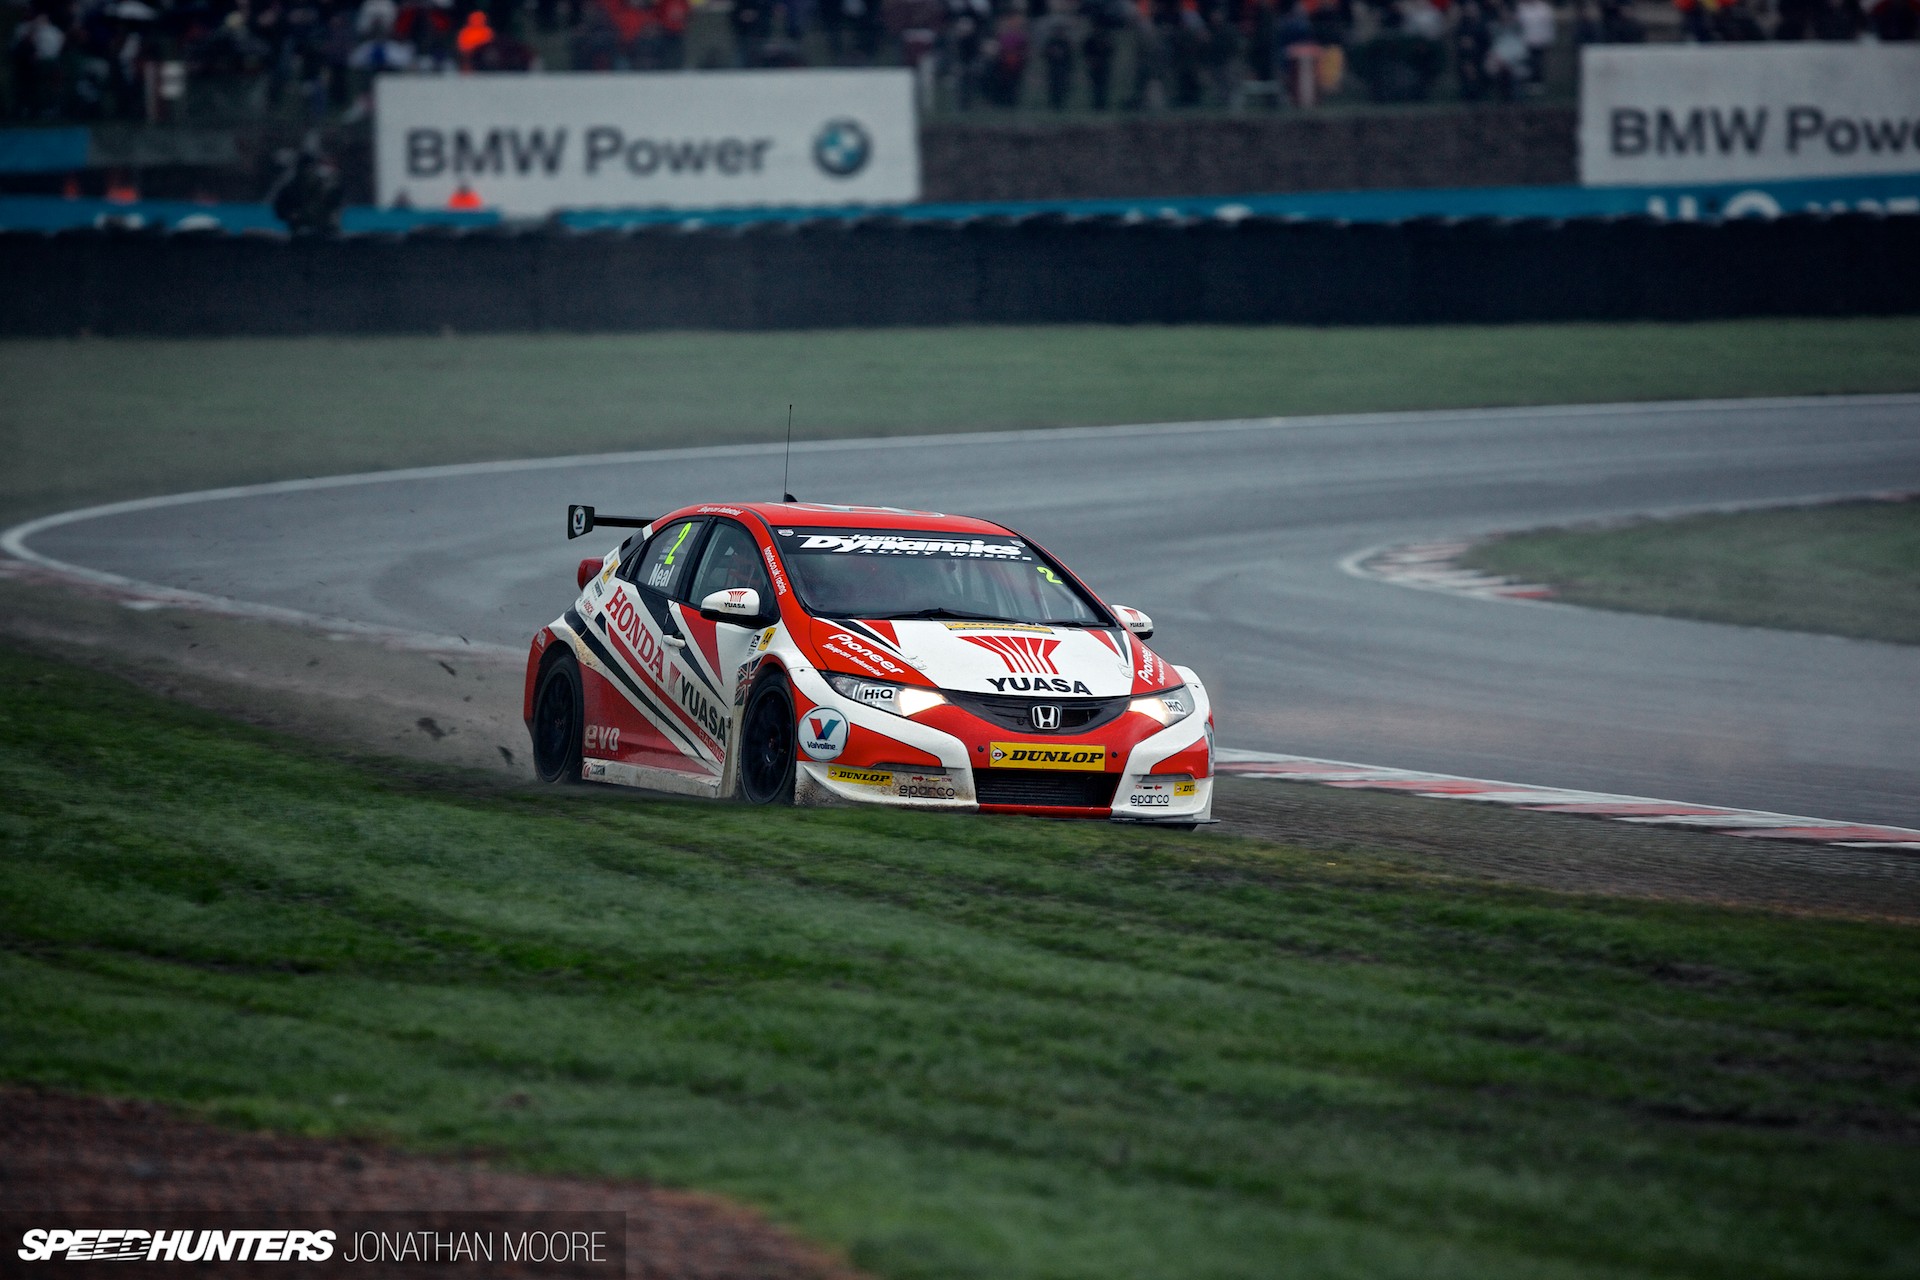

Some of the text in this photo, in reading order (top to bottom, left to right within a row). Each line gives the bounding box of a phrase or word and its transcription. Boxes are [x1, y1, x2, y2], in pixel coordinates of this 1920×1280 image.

[1609, 105, 1919, 156] BMW Pow
[405, 125, 774, 177] BMW Power
[664, 522, 692, 565] 2
[797, 535, 1022, 555] Dynamics
[648, 563, 675, 587] Neal
[1037, 566, 1063, 584] 2
[605, 585, 664, 683] HONDA
[828, 633, 904, 674] Pioneer
[1137, 647, 1154, 686] Pioneer
[864, 688, 893, 700] HiQ
[986, 677, 1093, 696] YUASA
[681, 675, 727, 747] YUASA
[1165, 701, 1185, 713] HiQ
[584, 724, 620, 752] evo
[807, 741, 836, 751] Valvoline
[1009, 750, 1104, 764] DUNLOP
[838, 770, 890, 782] DUNLOP
[899, 784, 955, 799] sparco
[1130, 794, 1170, 807] sparco
